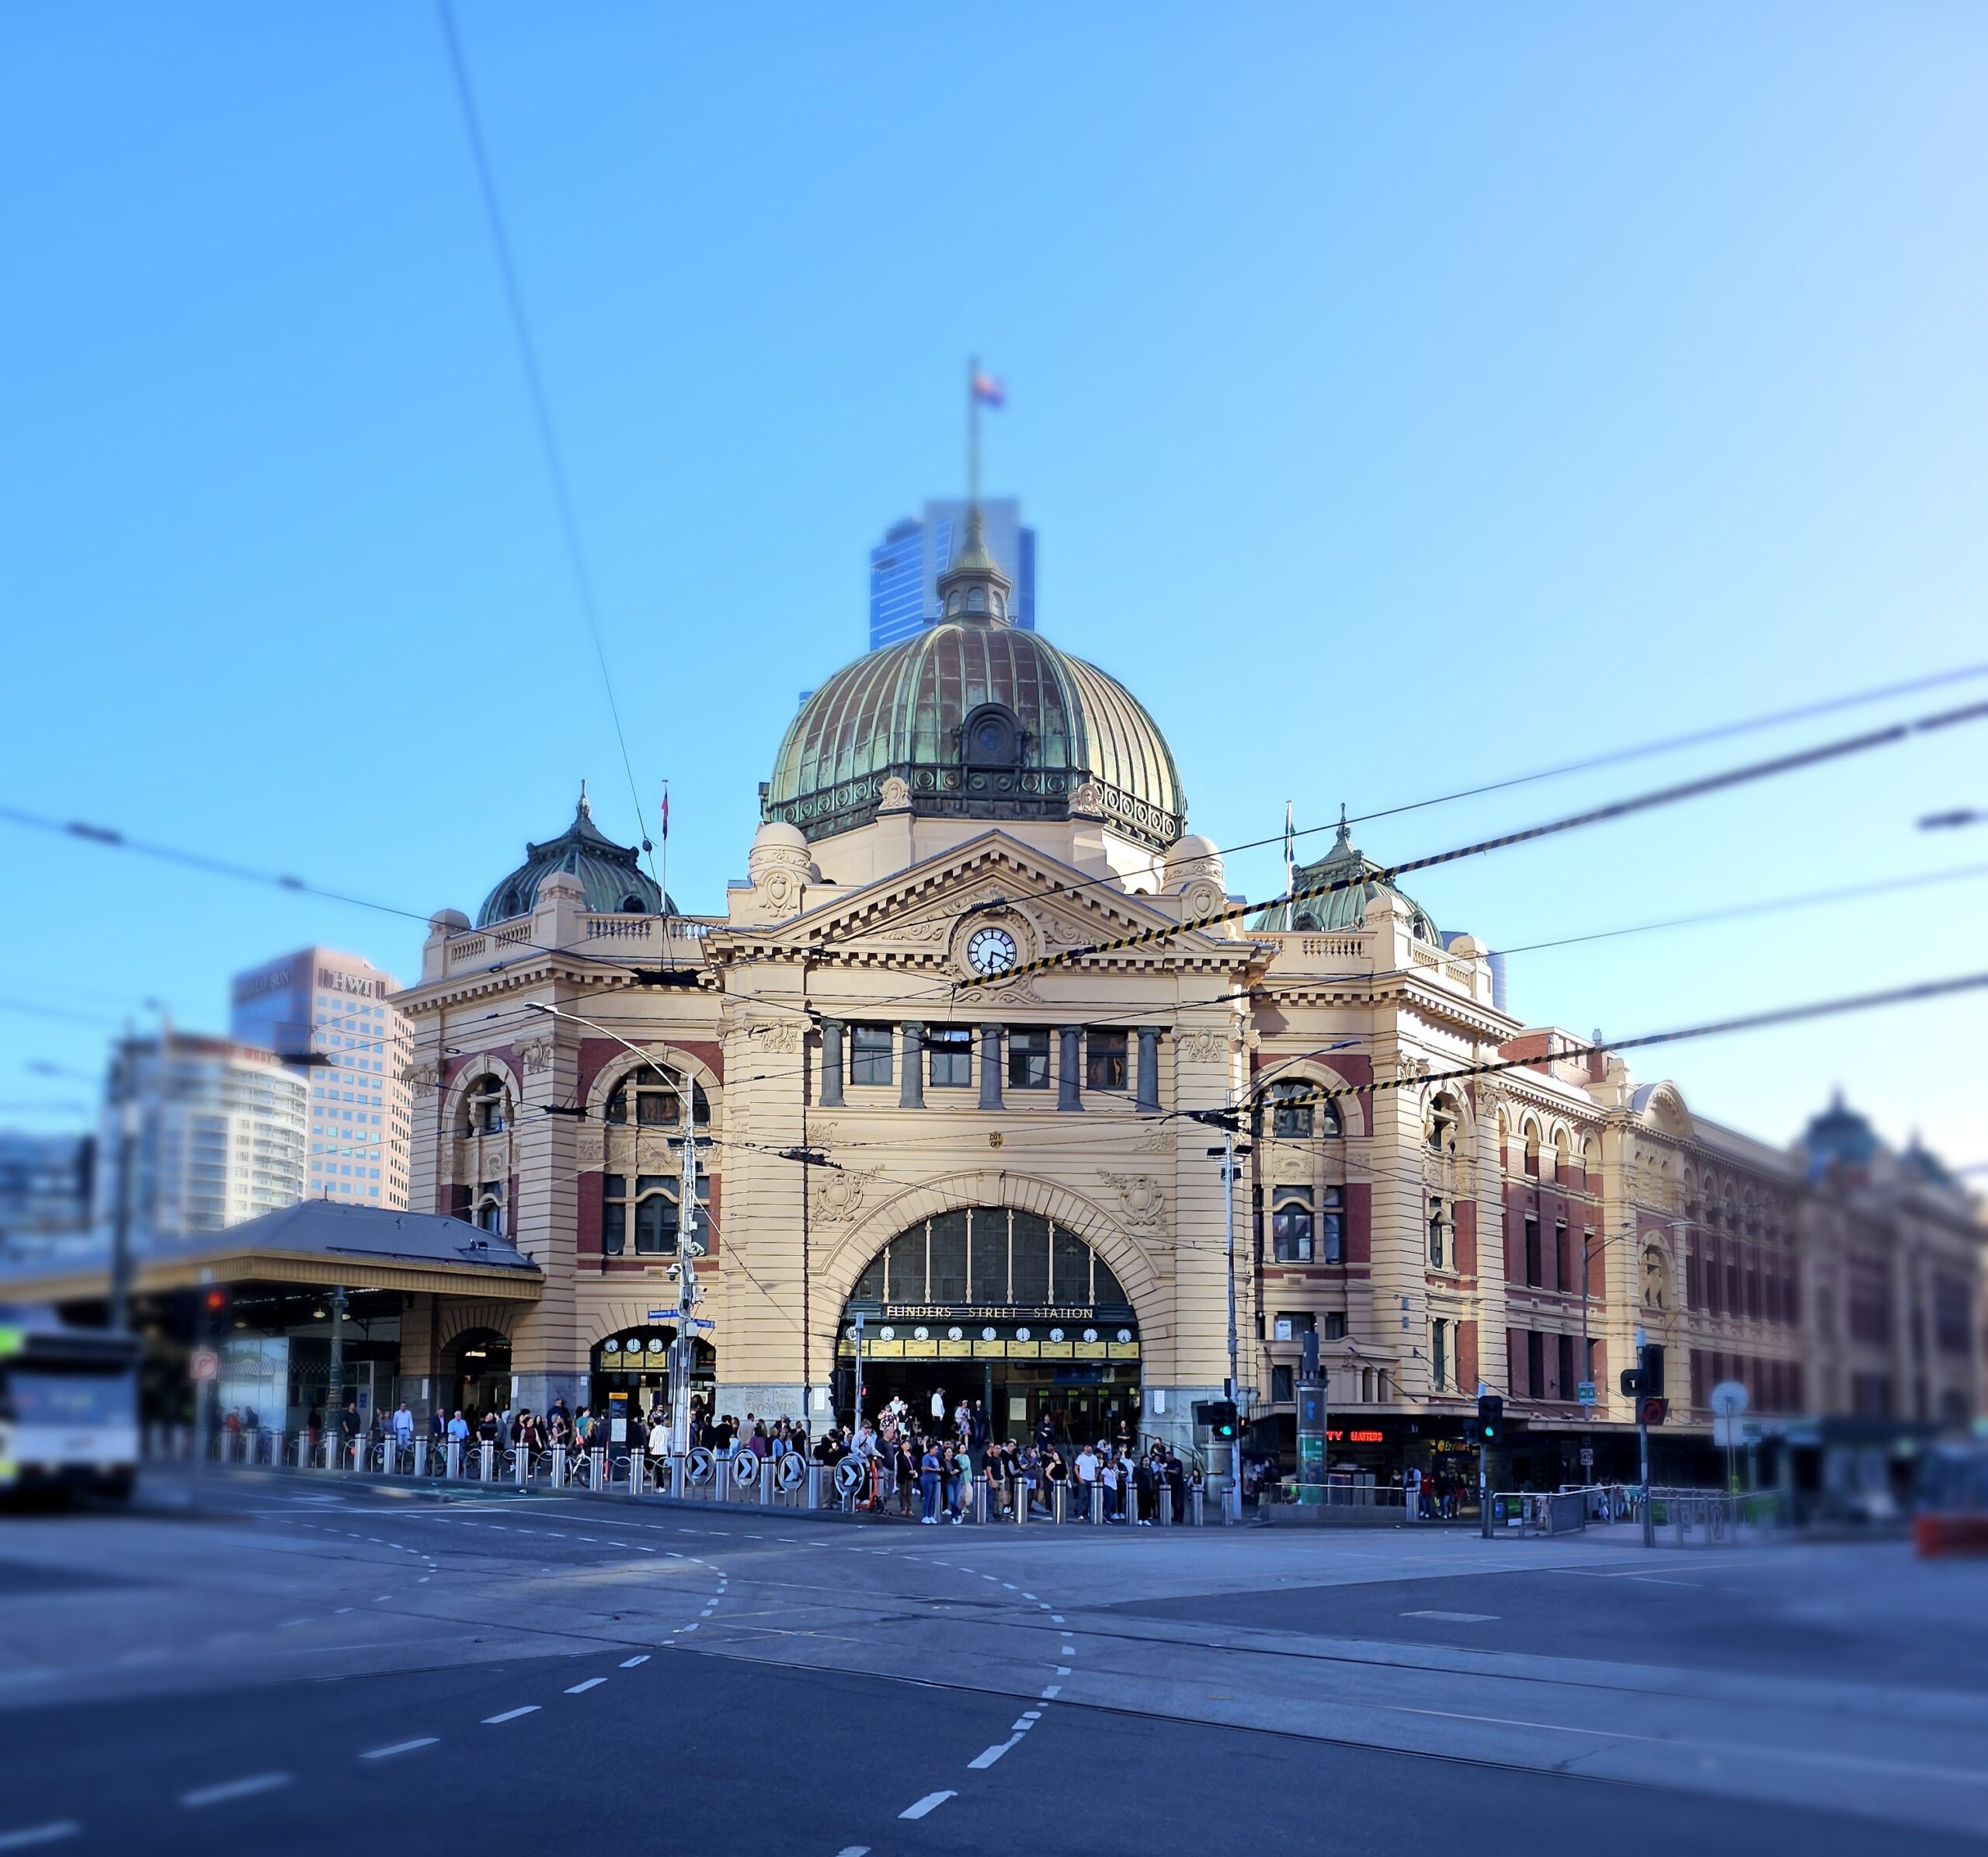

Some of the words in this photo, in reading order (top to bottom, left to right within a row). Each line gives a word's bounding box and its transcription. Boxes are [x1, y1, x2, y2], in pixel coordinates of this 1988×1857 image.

[270, 968, 290, 988] SUN
[332, 972, 374, 995] HWT
[886, 1306, 952, 1318] FLINDERS
[968, 1307, 1017, 1318] STREET
[1034, 1308, 1093, 1319] STATION
